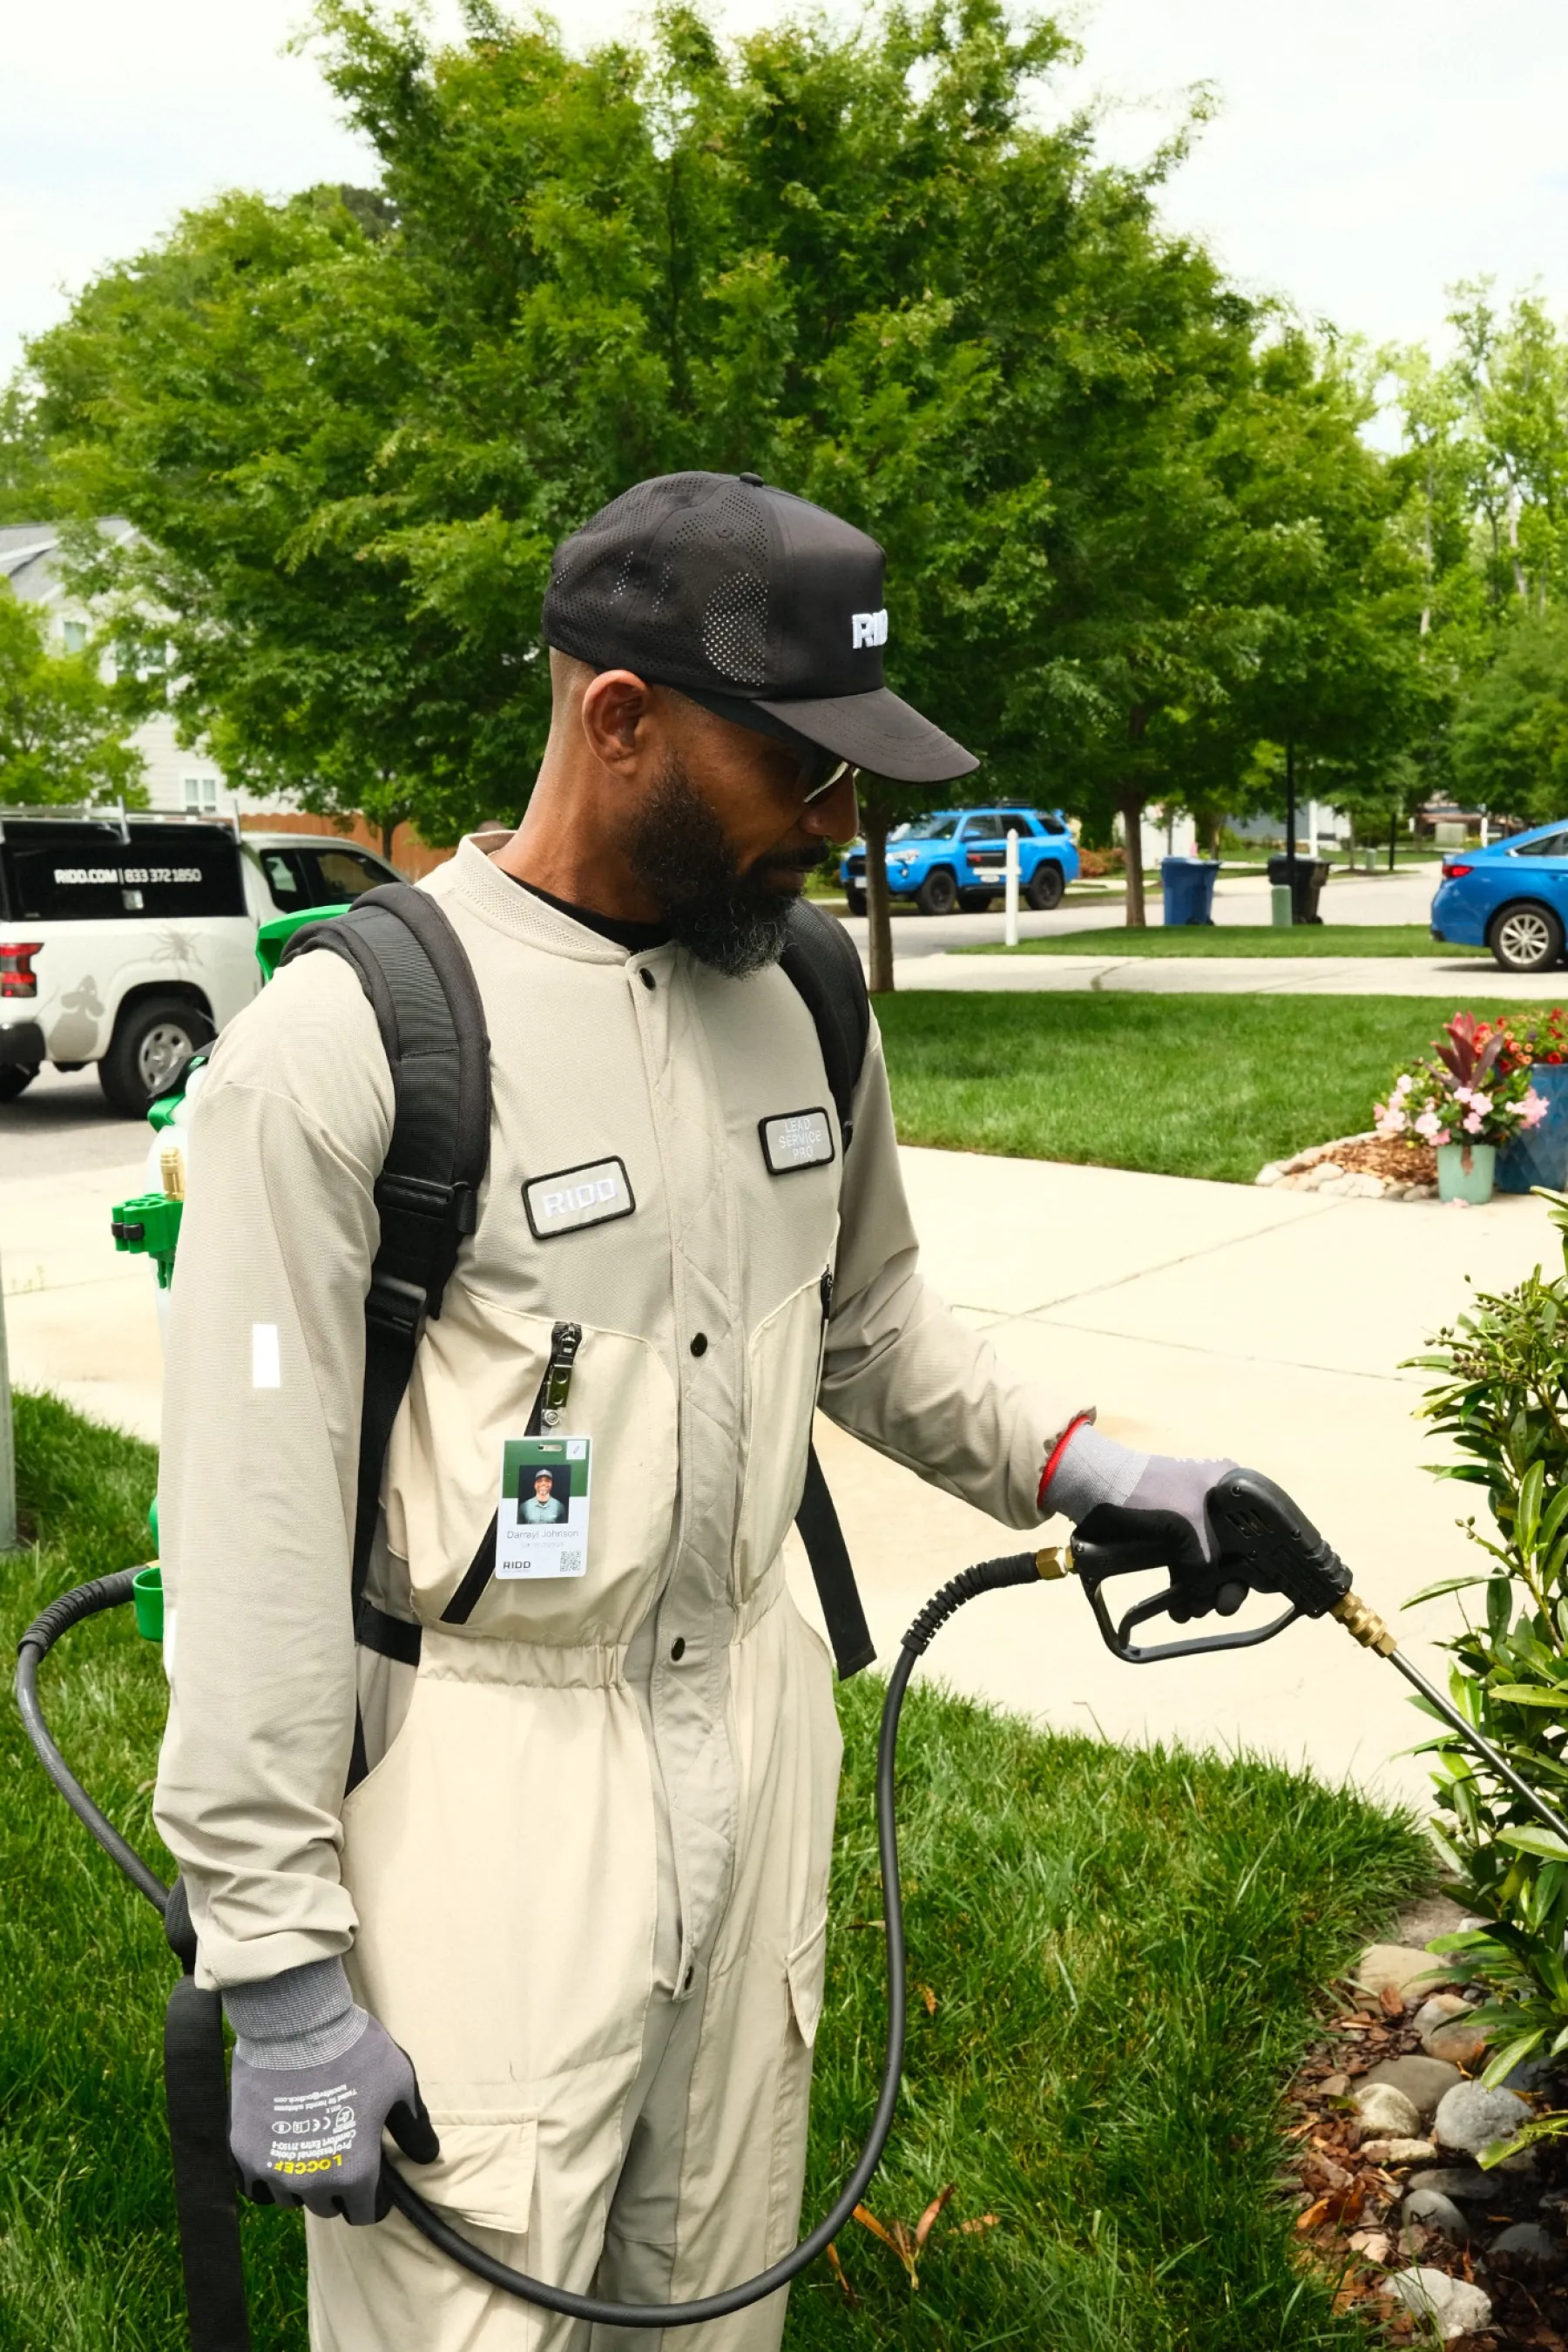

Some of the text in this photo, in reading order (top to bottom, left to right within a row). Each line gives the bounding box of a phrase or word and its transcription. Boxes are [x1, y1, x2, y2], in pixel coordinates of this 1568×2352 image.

[125, 868, 148, 883] 833
[149, 868, 172, 882] 372
[784, 1118, 810, 1133] LEAD
[779, 1131, 821, 1149] SERVICE
[792, 1145, 814, 1161] PRO
[543, 1178, 618, 1219] RIDD
[503, 1561, 531, 1570] RIDD
